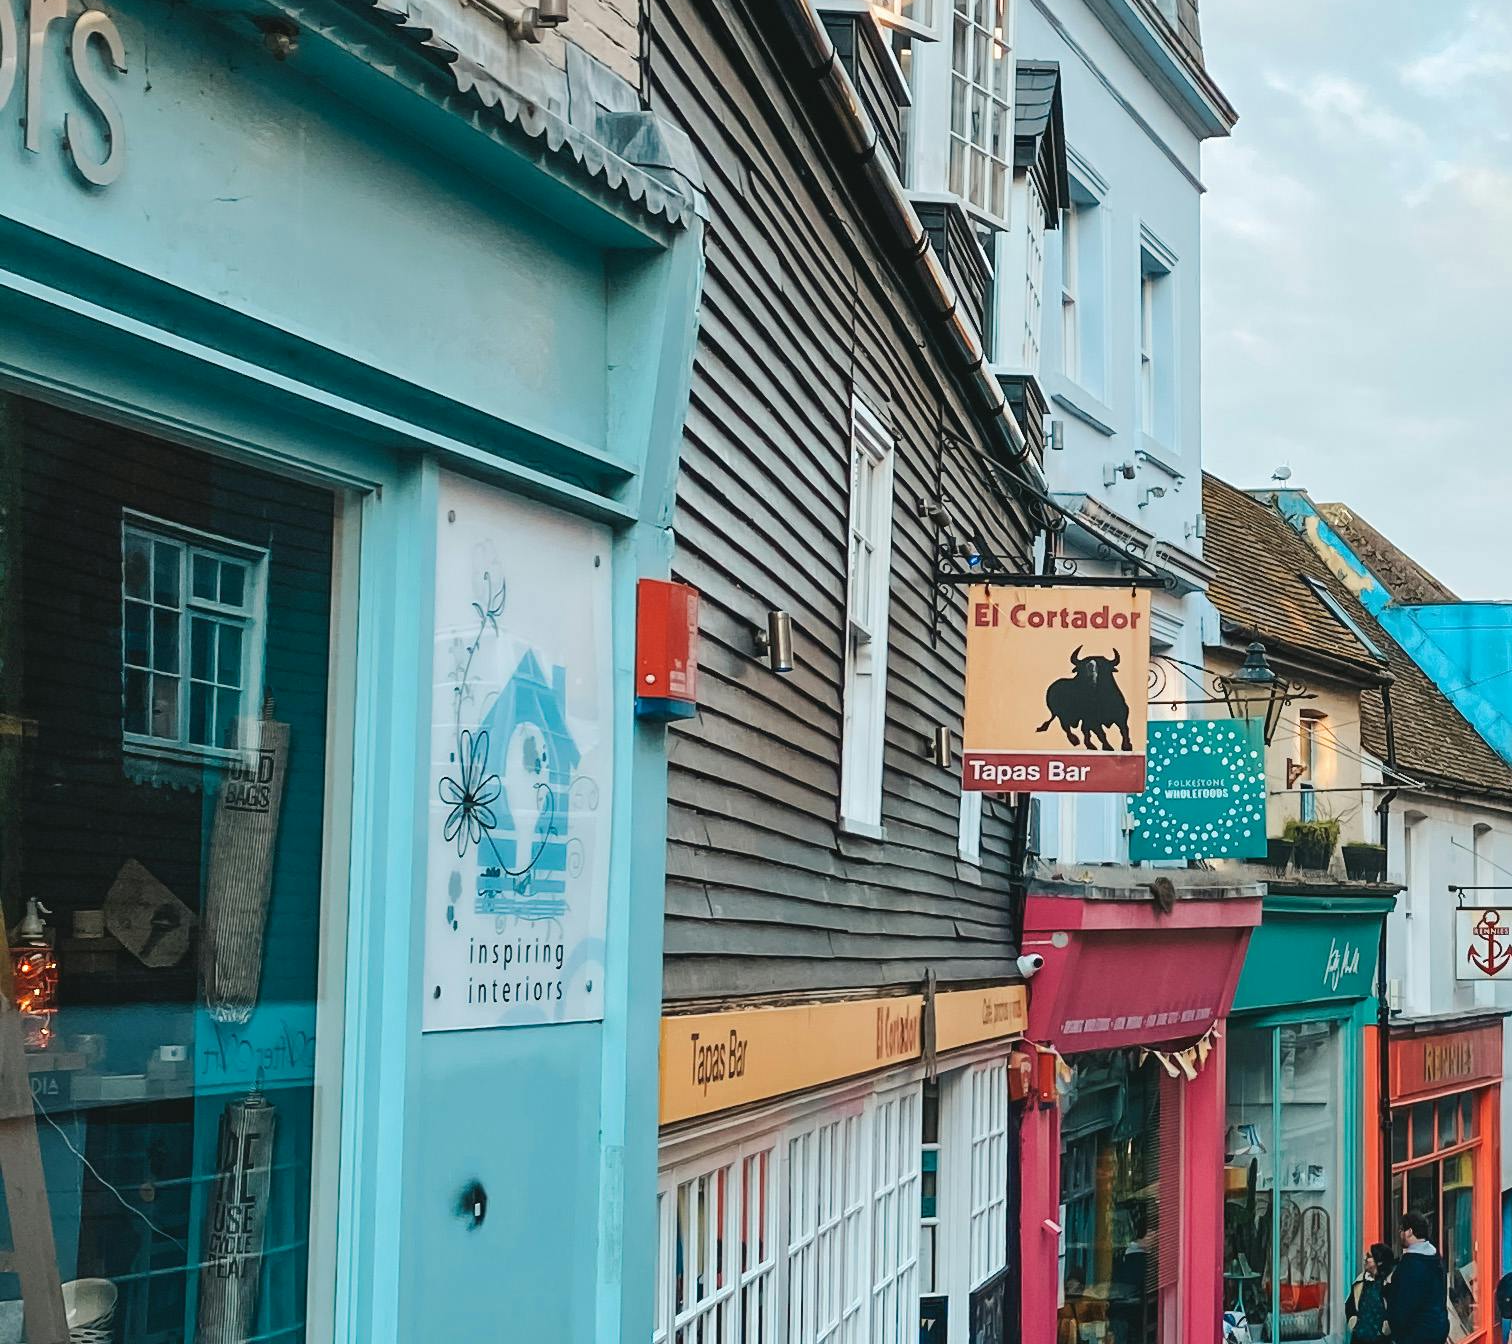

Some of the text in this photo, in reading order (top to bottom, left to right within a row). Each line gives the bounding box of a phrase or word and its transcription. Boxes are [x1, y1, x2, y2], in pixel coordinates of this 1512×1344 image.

[974, 602, 1141, 630] El Cortador
[969, 760, 1091, 784] Tapas Bar
[1167, 778, 1225, 788] FOLKESTONE
[470, 937, 564, 971] inspiring
[468, 976, 562, 1004] interiors
[690, 1029, 748, 1097] Tapas Bar
[1425, 1042, 1472, 1083] RENNIES
